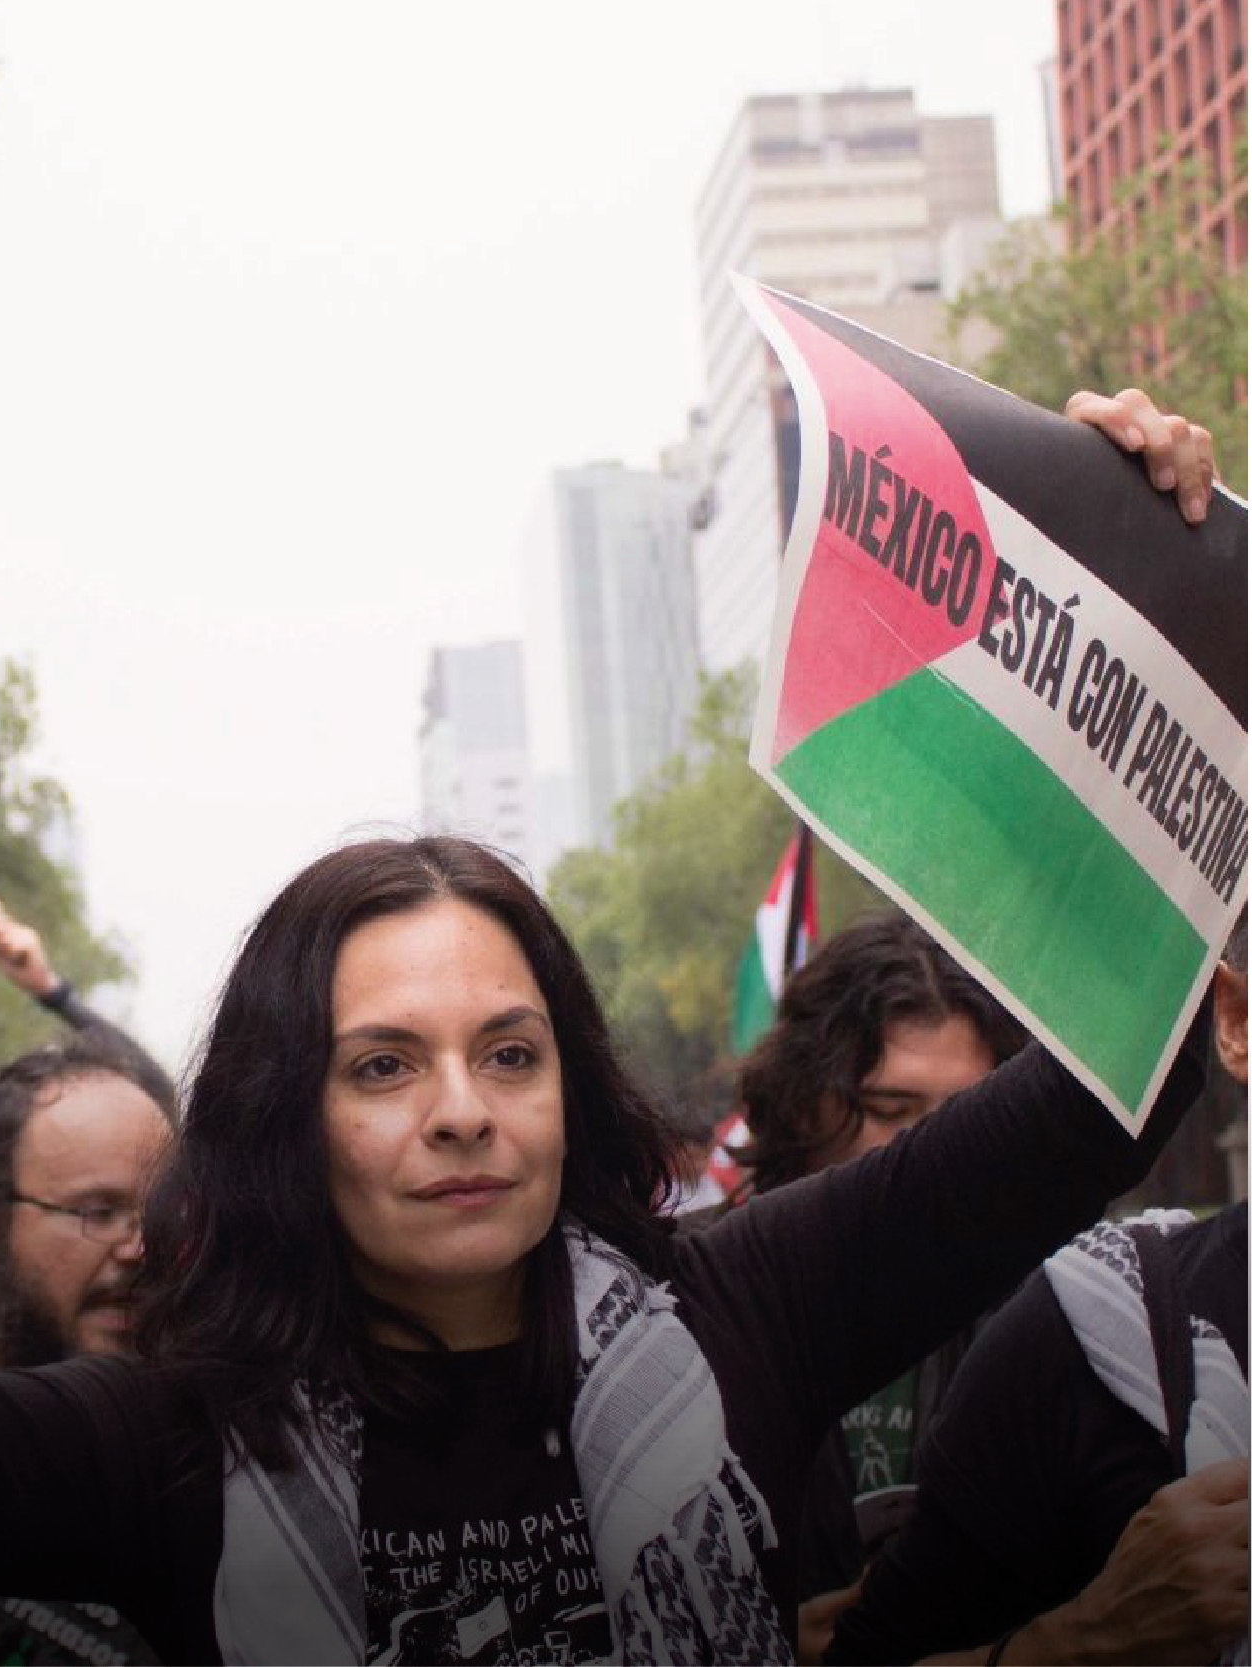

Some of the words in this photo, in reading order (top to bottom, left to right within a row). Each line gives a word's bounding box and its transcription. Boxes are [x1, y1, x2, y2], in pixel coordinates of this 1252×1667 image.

[823, 430, 983, 628] MÉXICO
[977, 556, 1080, 712] ESTÁ
[1067, 638, 1147, 771] CON
[1122, 699, 1248, 906] PALESTINA
[461, 1518, 510, 1549] AND
[520, 1497, 587, 1546] PALE
[389, 1560, 442, 1591] THE
[459, 1545, 553, 1585] ISRAELI
[514, 1581, 542, 1613] OF
